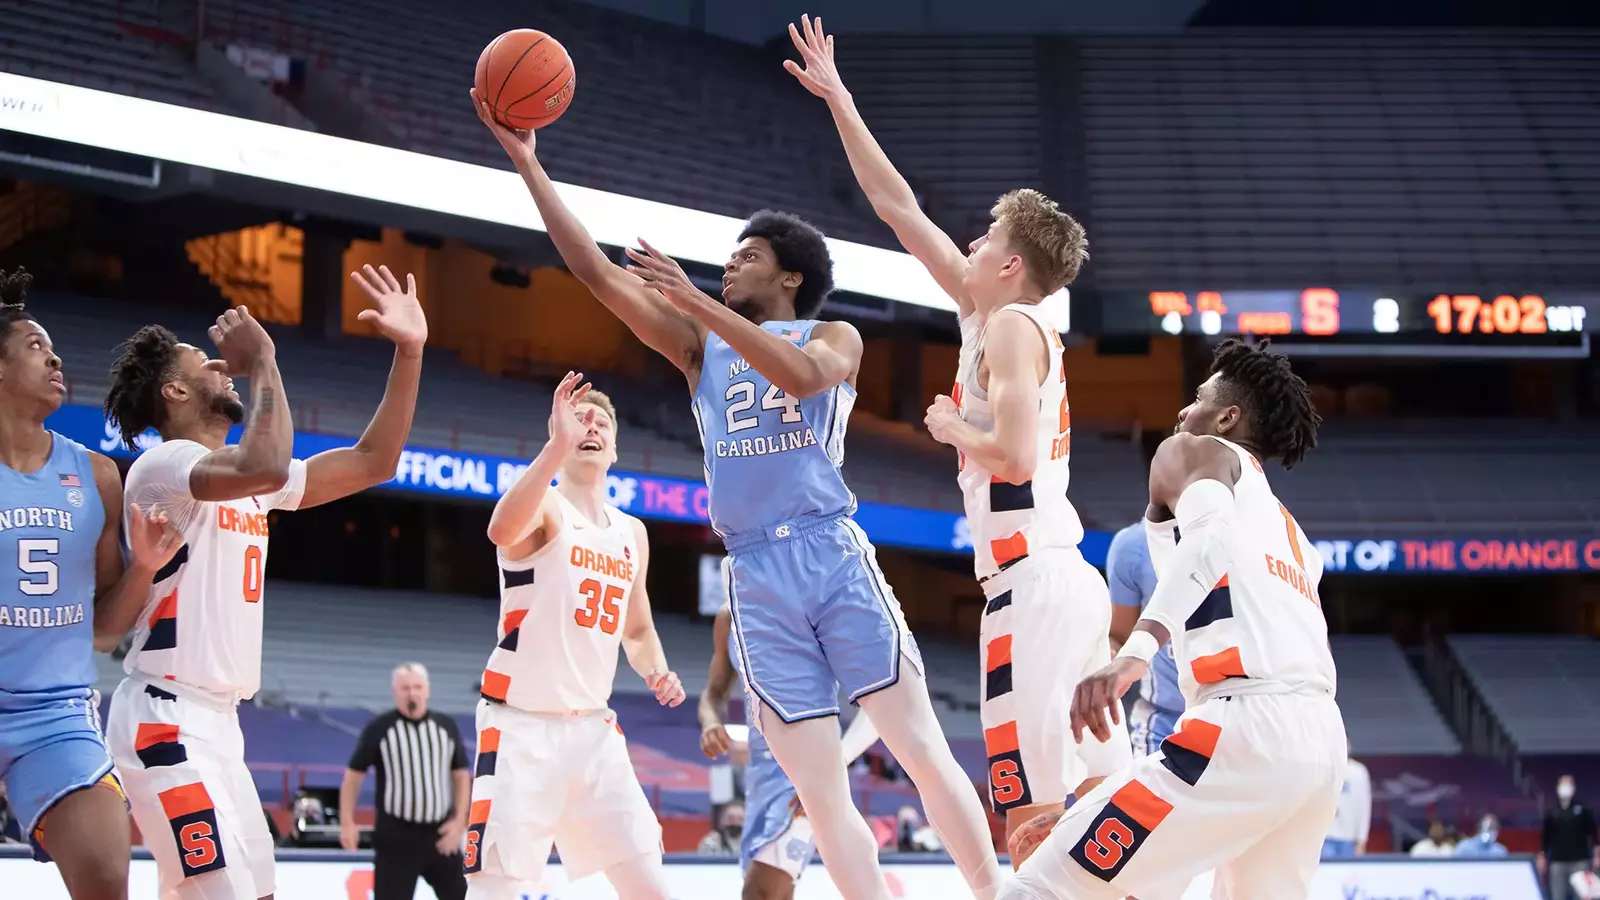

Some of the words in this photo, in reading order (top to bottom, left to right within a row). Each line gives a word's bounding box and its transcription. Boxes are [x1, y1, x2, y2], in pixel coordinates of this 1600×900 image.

[1427, 294, 1547, 334] 17:02
[725, 381, 802, 434] 24
[716, 427, 817, 458] CAROLINA
[396, 451, 494, 494] FFICIAL
[0, 507, 74, 532] NORTH
[18, 538, 59, 596] 5
[243, 545, 262, 603] 0
[570, 545, 633, 583] ORANGE
[1353, 540, 1397, 571] OF
[1402, 541, 1456, 570] THE
[1461, 540, 1578, 570] ORANGE
[0, 602, 84, 628] AROLINA
[574, 578, 625, 635] 35
[990, 759, 1024, 804] S
[180, 821, 217, 868] S
[1084, 817, 1135, 870] S
